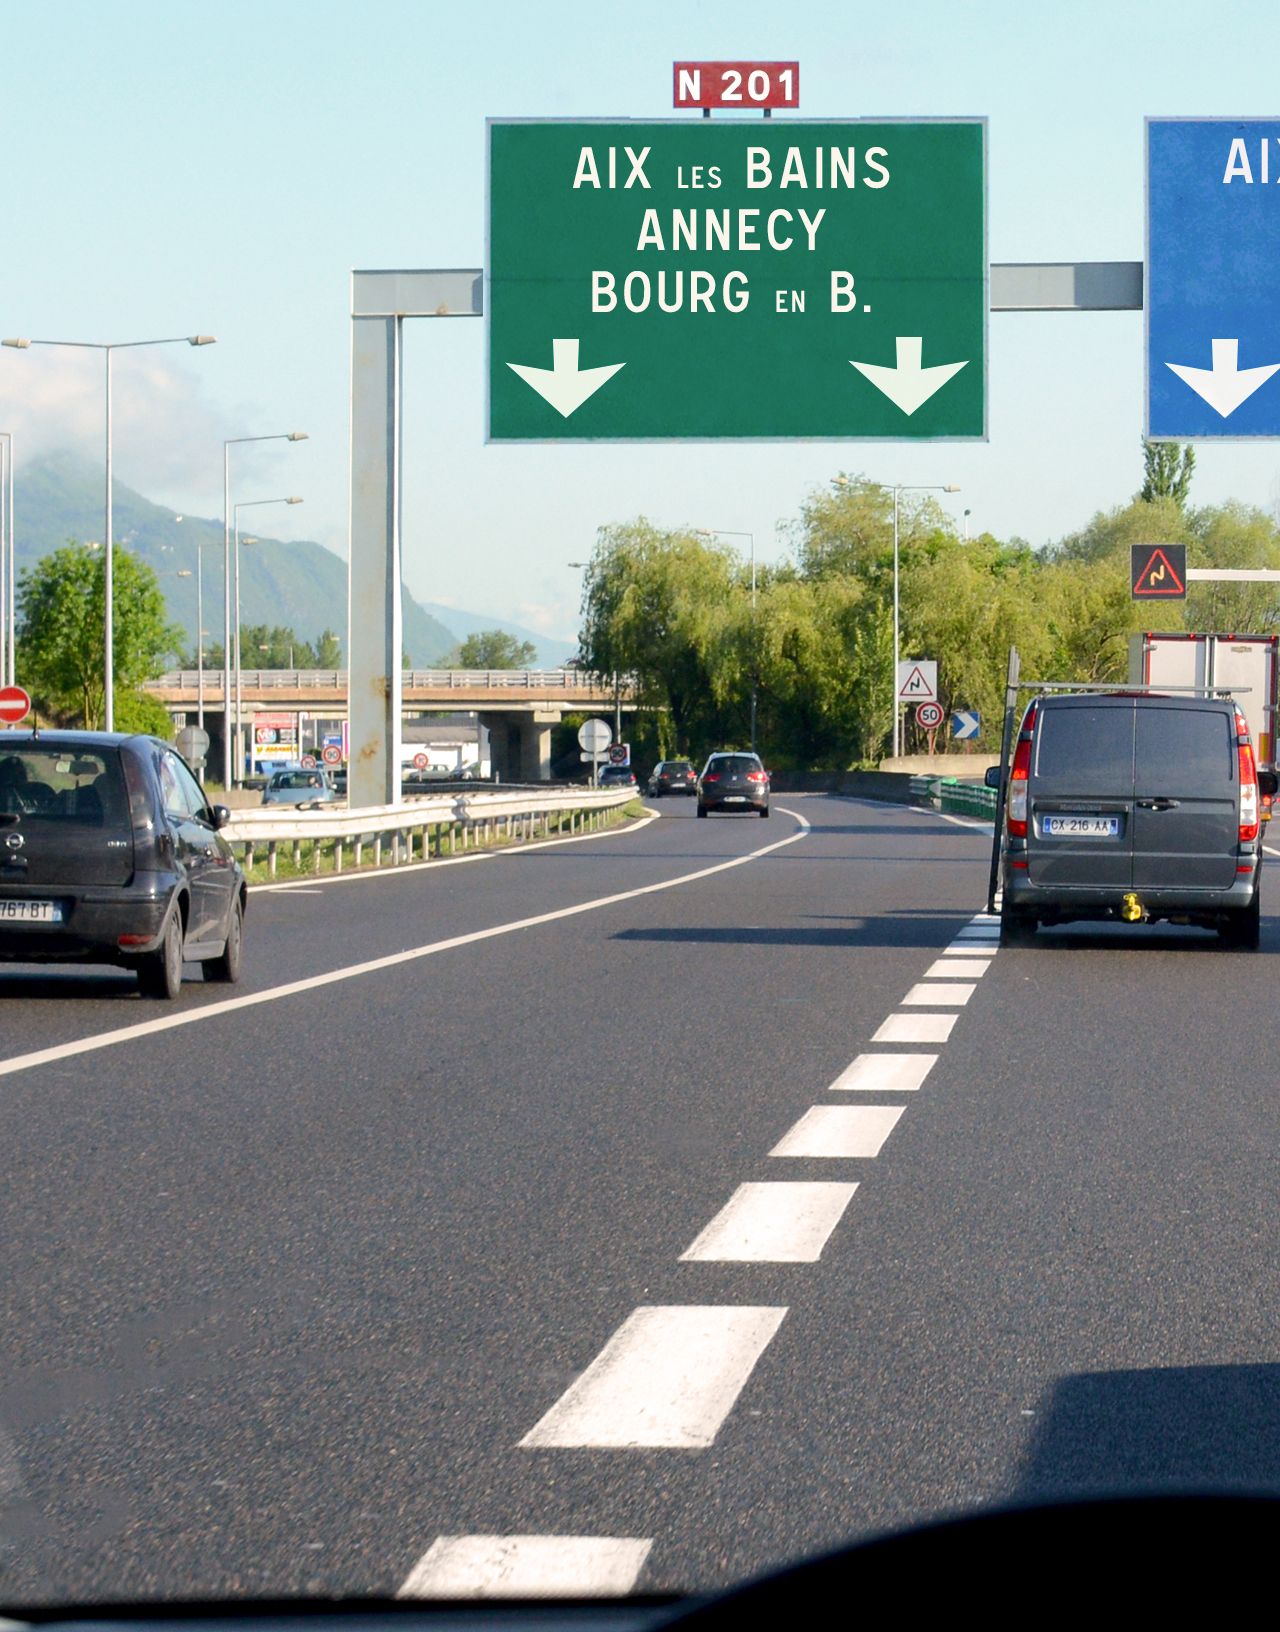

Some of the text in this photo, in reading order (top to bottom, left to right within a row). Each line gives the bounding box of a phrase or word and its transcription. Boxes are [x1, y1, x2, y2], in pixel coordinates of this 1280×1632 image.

[678, 69, 794, 101] N 201
[572, 145, 892, 190] AIX LES BAINS
[636, 208, 826, 251] ANNECY
[591, 269, 872, 314] BOURG EN B.
[922, 709, 938, 721] 50
